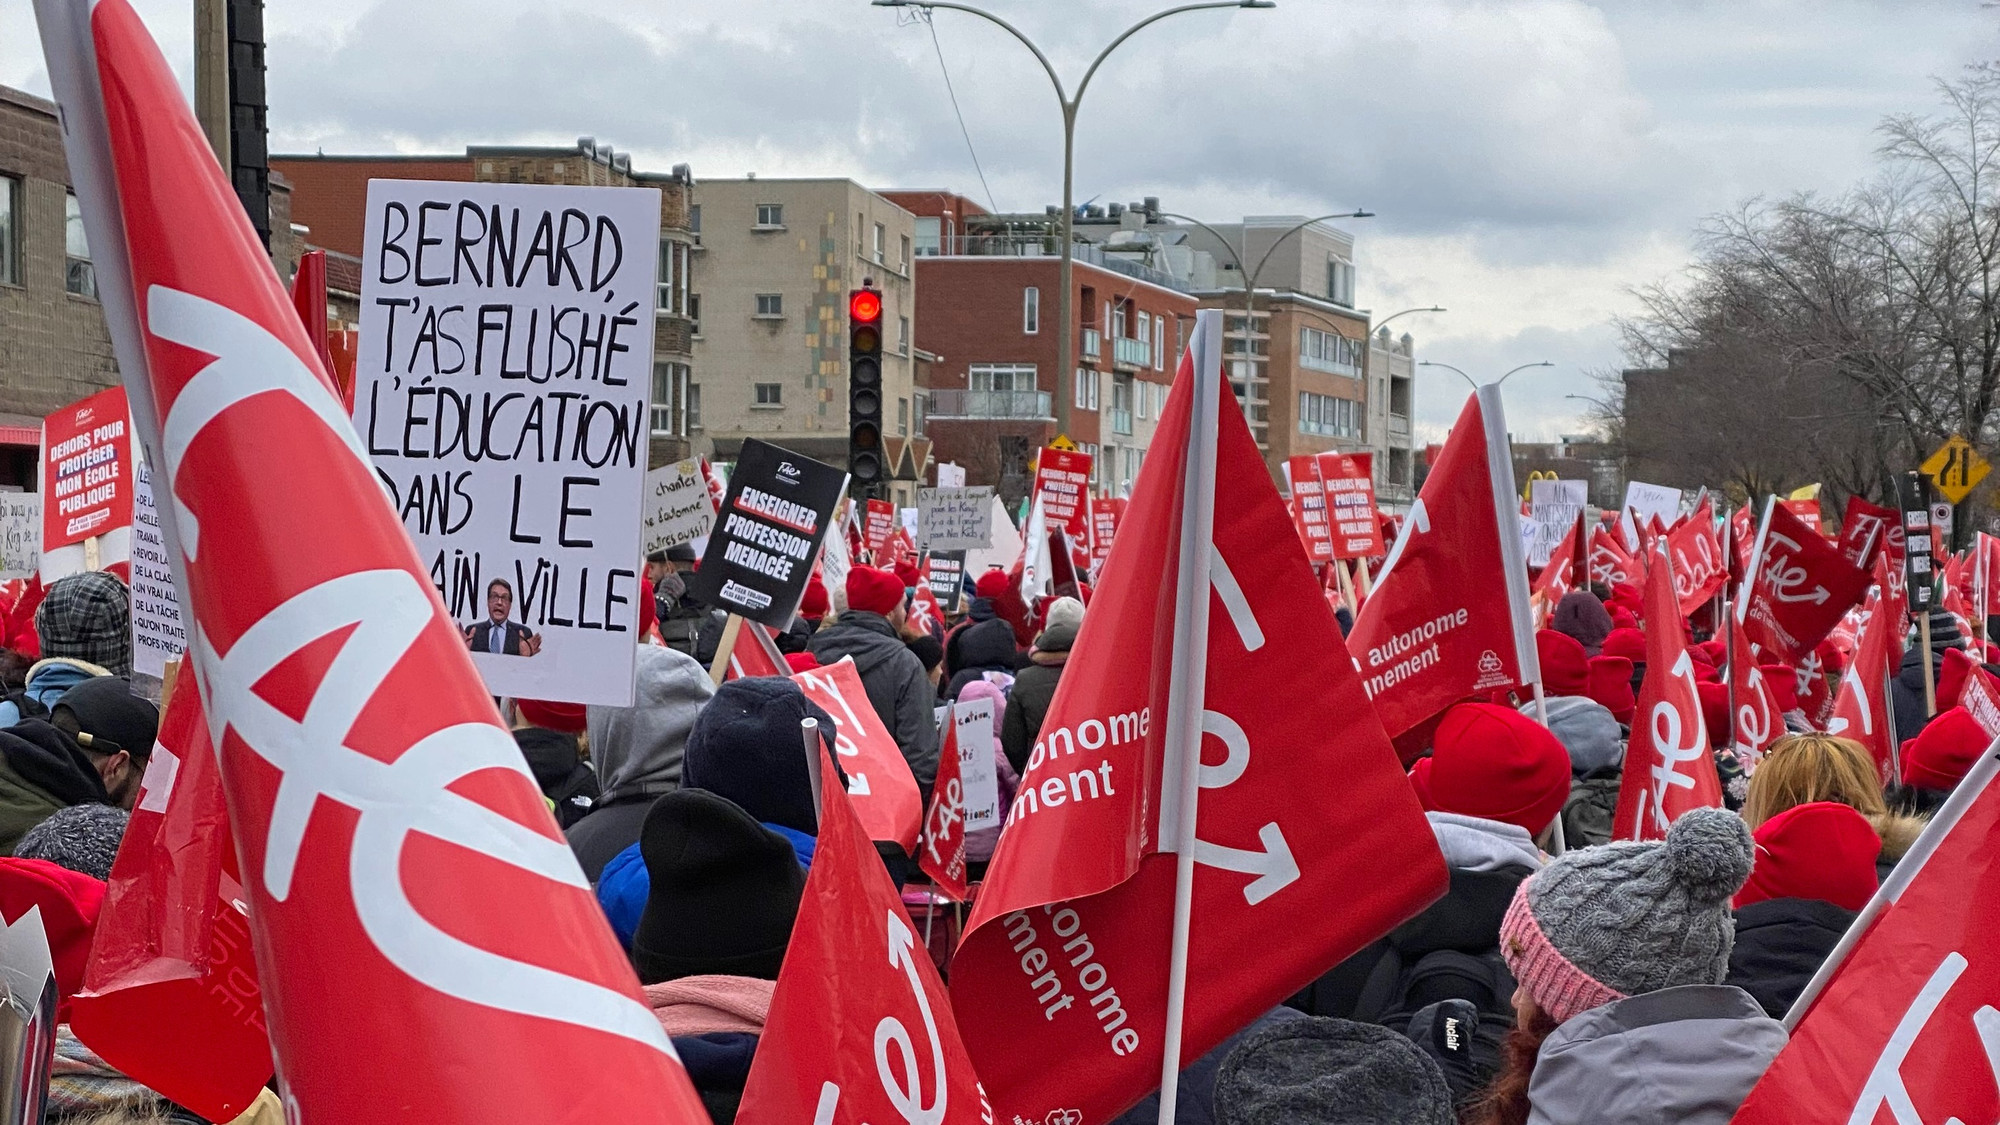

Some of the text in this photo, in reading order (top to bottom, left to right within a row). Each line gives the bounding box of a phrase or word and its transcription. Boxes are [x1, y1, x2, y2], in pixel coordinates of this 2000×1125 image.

[379, 199, 623, 303] BERNARD,
[376, 296, 640, 386] T'AS FLUSHÉ
[51, 420, 124, 462] DEHORS POUR
[59, 443, 114, 477] PROTÉGER
[56, 461, 119, 498] MON ÉCOLE
[656, 474, 697, 496] chanter
[1326, 478, 1371, 491] DEHORS POUR
[59, 482, 116, 516] PUBLIQUE!
[738, 485, 818, 531] ENSEIGNER
[1303, 495, 1326, 508] PROT
[1335, 491, 1368, 506] PROTÉGER
[1335, 507, 1353, 520] MON
[1354, 505, 1373, 519] ÉCOLE
[138, 511, 161, 528] MEILLE
[1307, 525, 1329, 537] PUBLI
[136, 529, 159, 546] TRAVAIL
[723, 512, 812, 561] PROFESSION
[136, 547, 159, 564] REVOIR
[724, 540, 794, 582] MENACÉE
[135, 565, 174, 585] DE LA CLAS
[136, 582, 178, 603] UN VRAI ALL
[136, 599, 180, 620] DE LA TÂCHE
[138, 617, 185, 639] QU'ON TRAITE
[1368, 607, 1469, 668] autonome
[138, 634, 185, 655] PROFS PRÉCA
[1363, 642, 1441, 701] nement
[958, 711, 991, 726] cation,
[1022, 706, 1150, 782] onome
[1002, 759, 1115, 835] ment
[963, 802, 995, 821] tions!
[1003, 908, 1075, 1021] ment
[1044, 902, 1140, 1056] onome
[1445, 1017, 1460, 1051] Auclair
